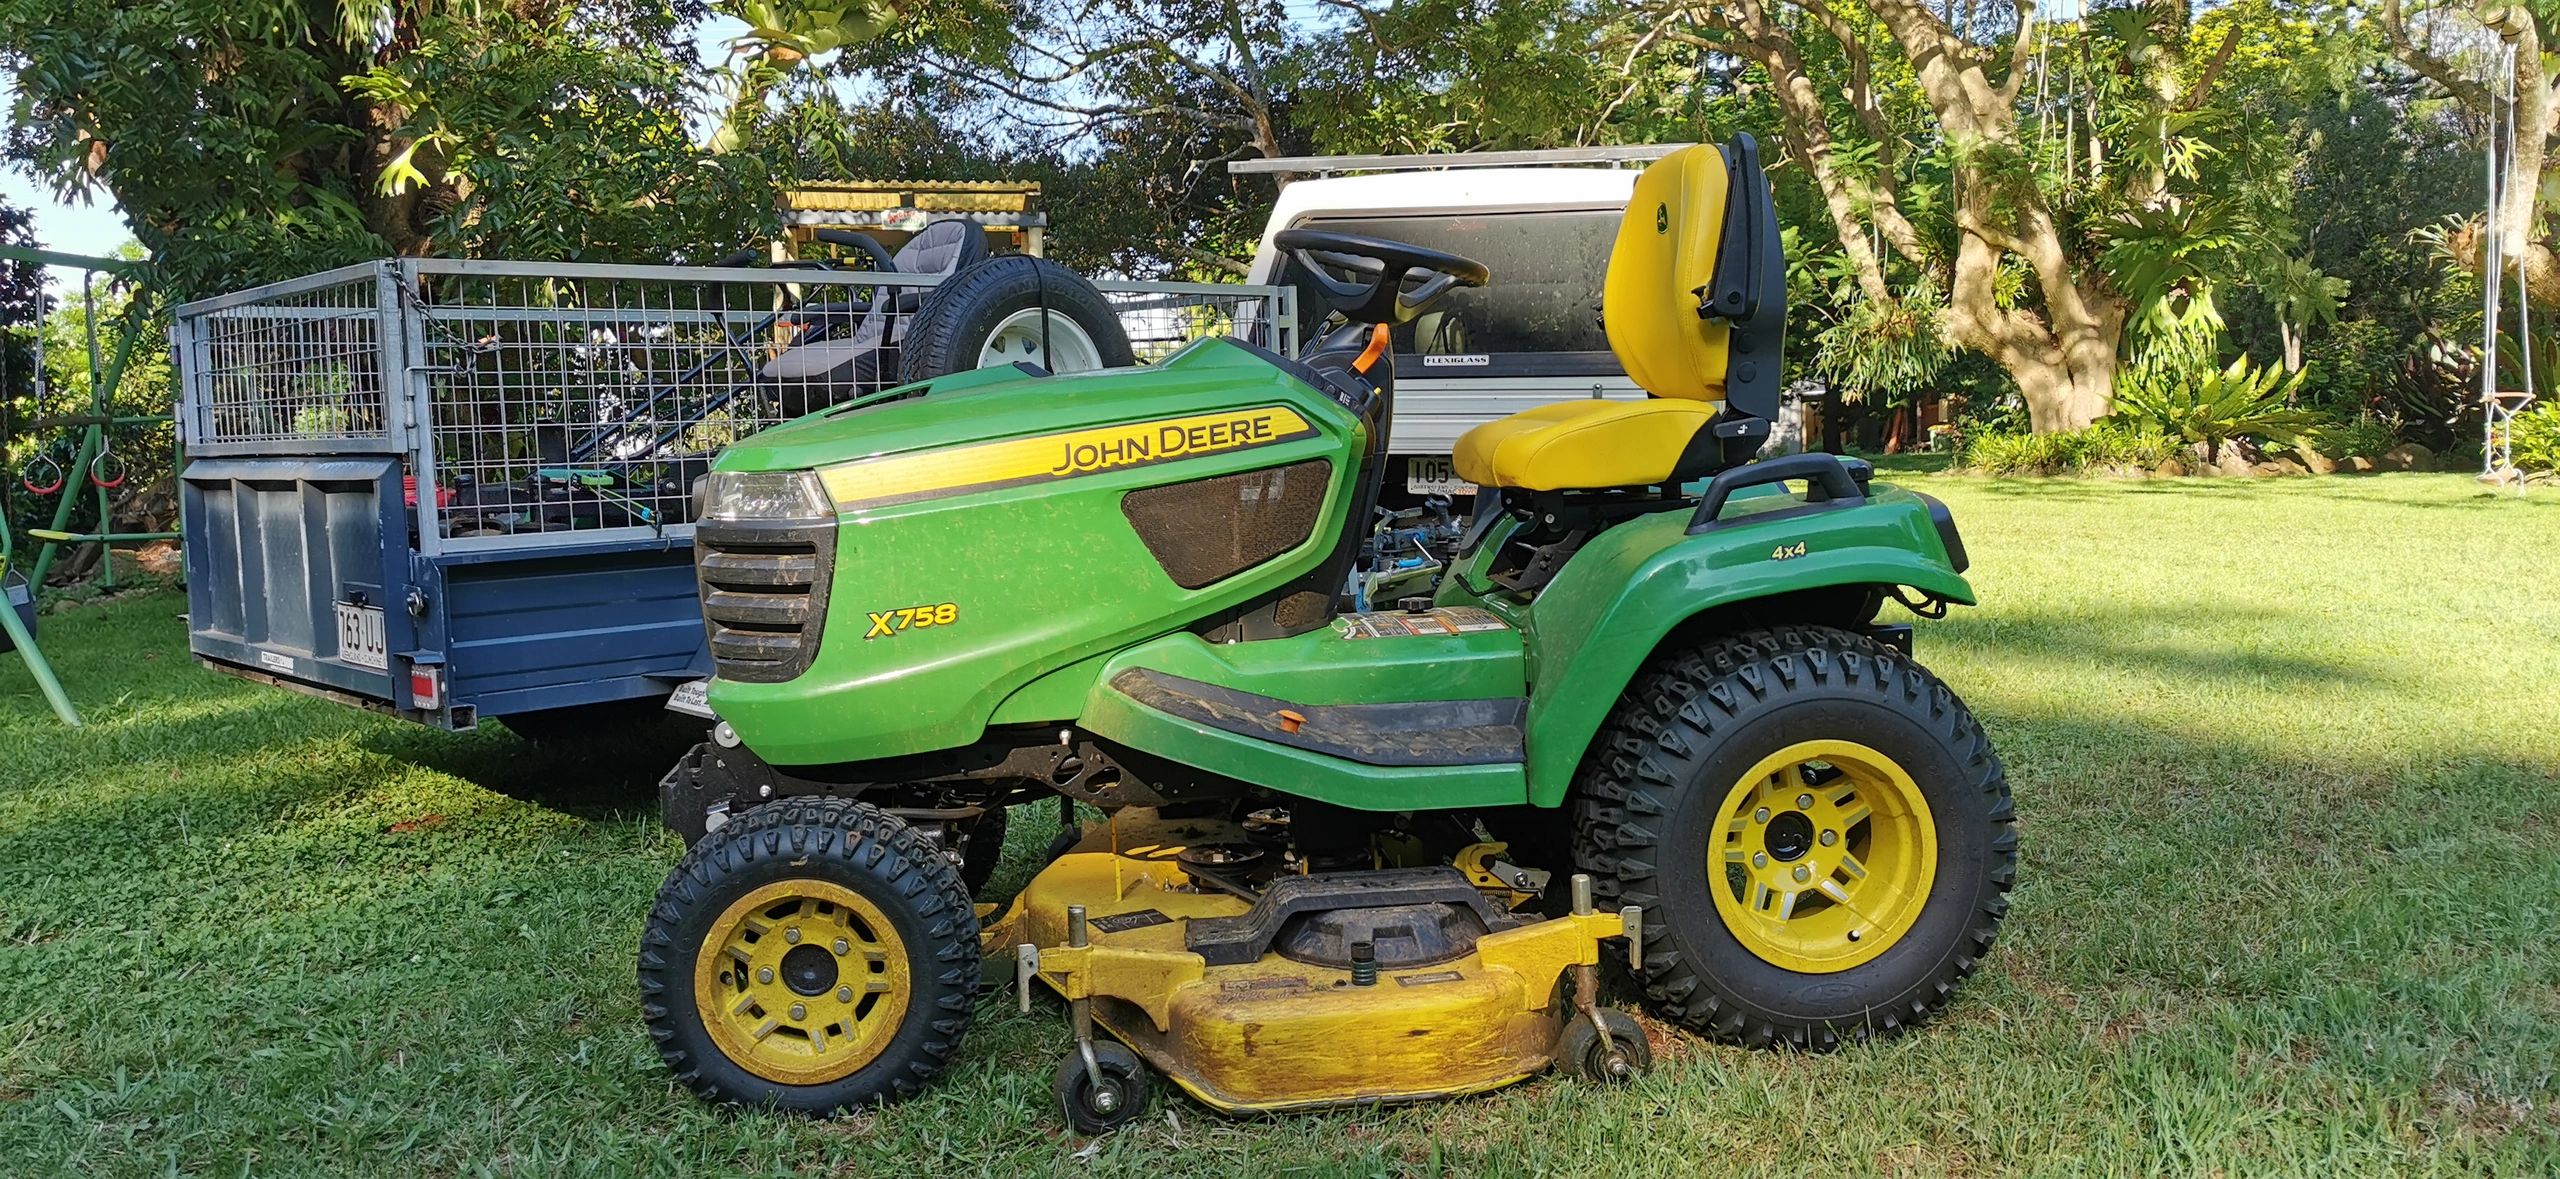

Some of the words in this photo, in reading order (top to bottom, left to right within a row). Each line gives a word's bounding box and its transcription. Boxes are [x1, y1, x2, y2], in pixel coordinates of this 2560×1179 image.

[1052, 435, 1149, 472] JOHN
[1160, 415, 1273, 454] DEERE
[1771, 540, 1806, 560] 4x4
[863, 602, 959, 639] X758
